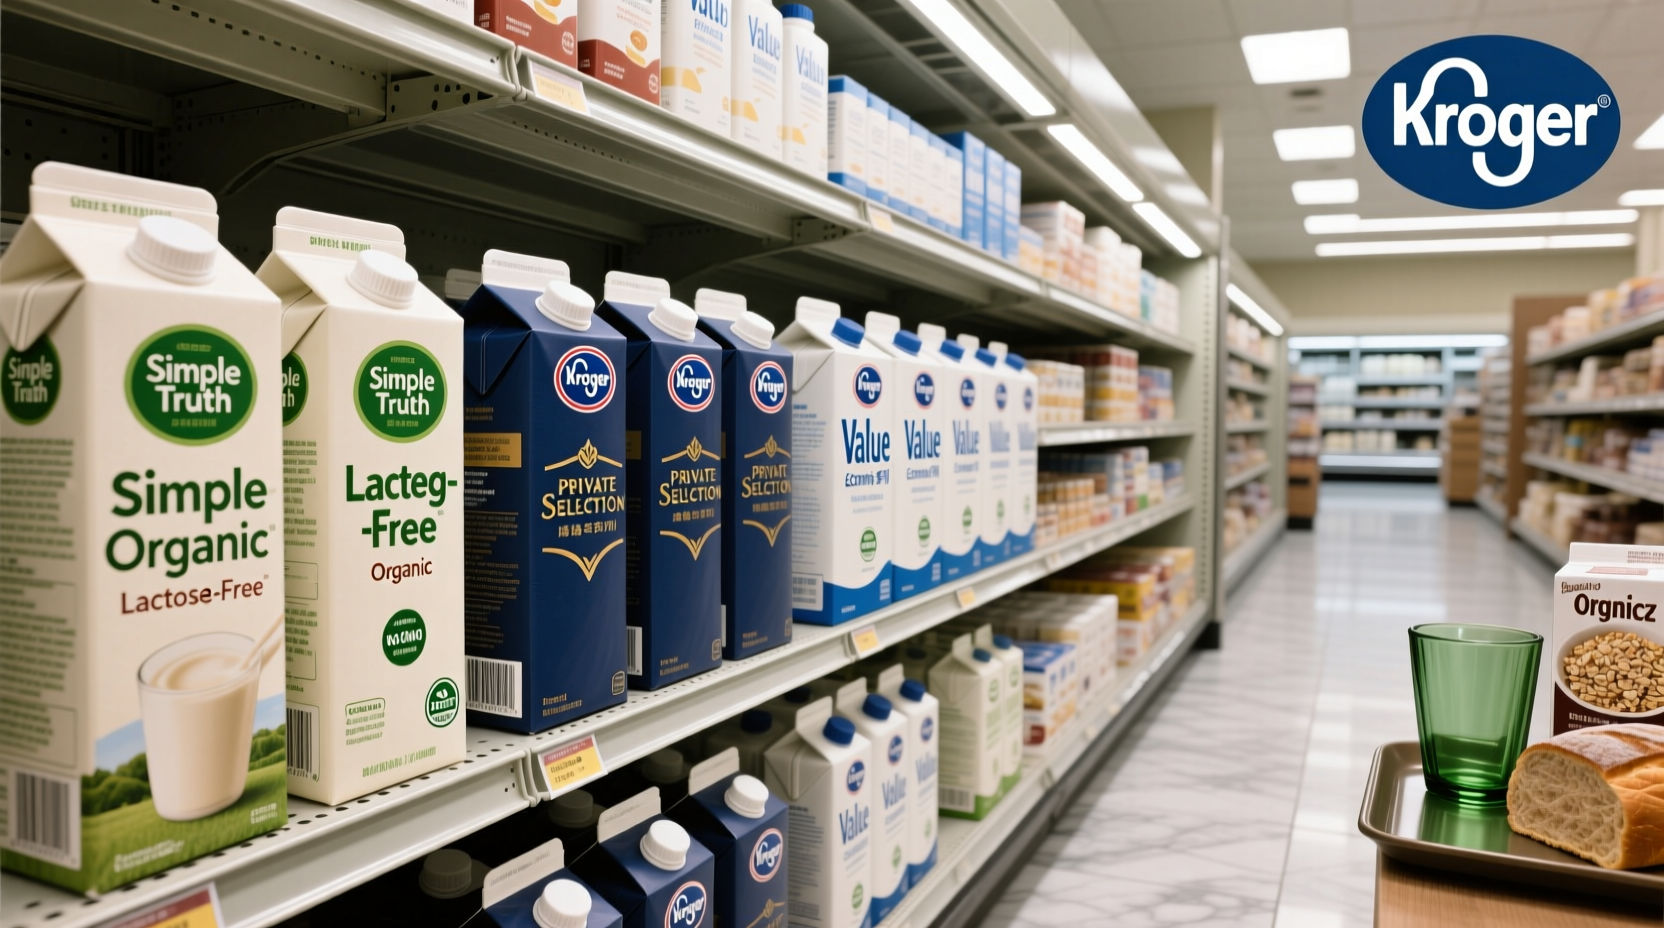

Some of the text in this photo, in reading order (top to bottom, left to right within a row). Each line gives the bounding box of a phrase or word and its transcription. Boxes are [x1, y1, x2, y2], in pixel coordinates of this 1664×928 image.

[146, 353, 241, 392] Simple
[369, 366, 435, 396] Simple
[566, 357, 610, 398] Kroger
[154, 385, 232, 413] Truth
[375, 392, 430, 416] Truth
[841, 418, 890, 464] Value
[904, 419, 941, 460] Value
[111, 467, 268, 524] Simple
[558, 476, 617, 496] PRIVATE
[362, 508, 437, 548] -Free
[105, 520, 269, 579] Organic
[370, 556, 433, 584] Organic
[120, 578, 264, 614] Lactose-Free
[1574, 593, 1657, 623] Orgnicz
